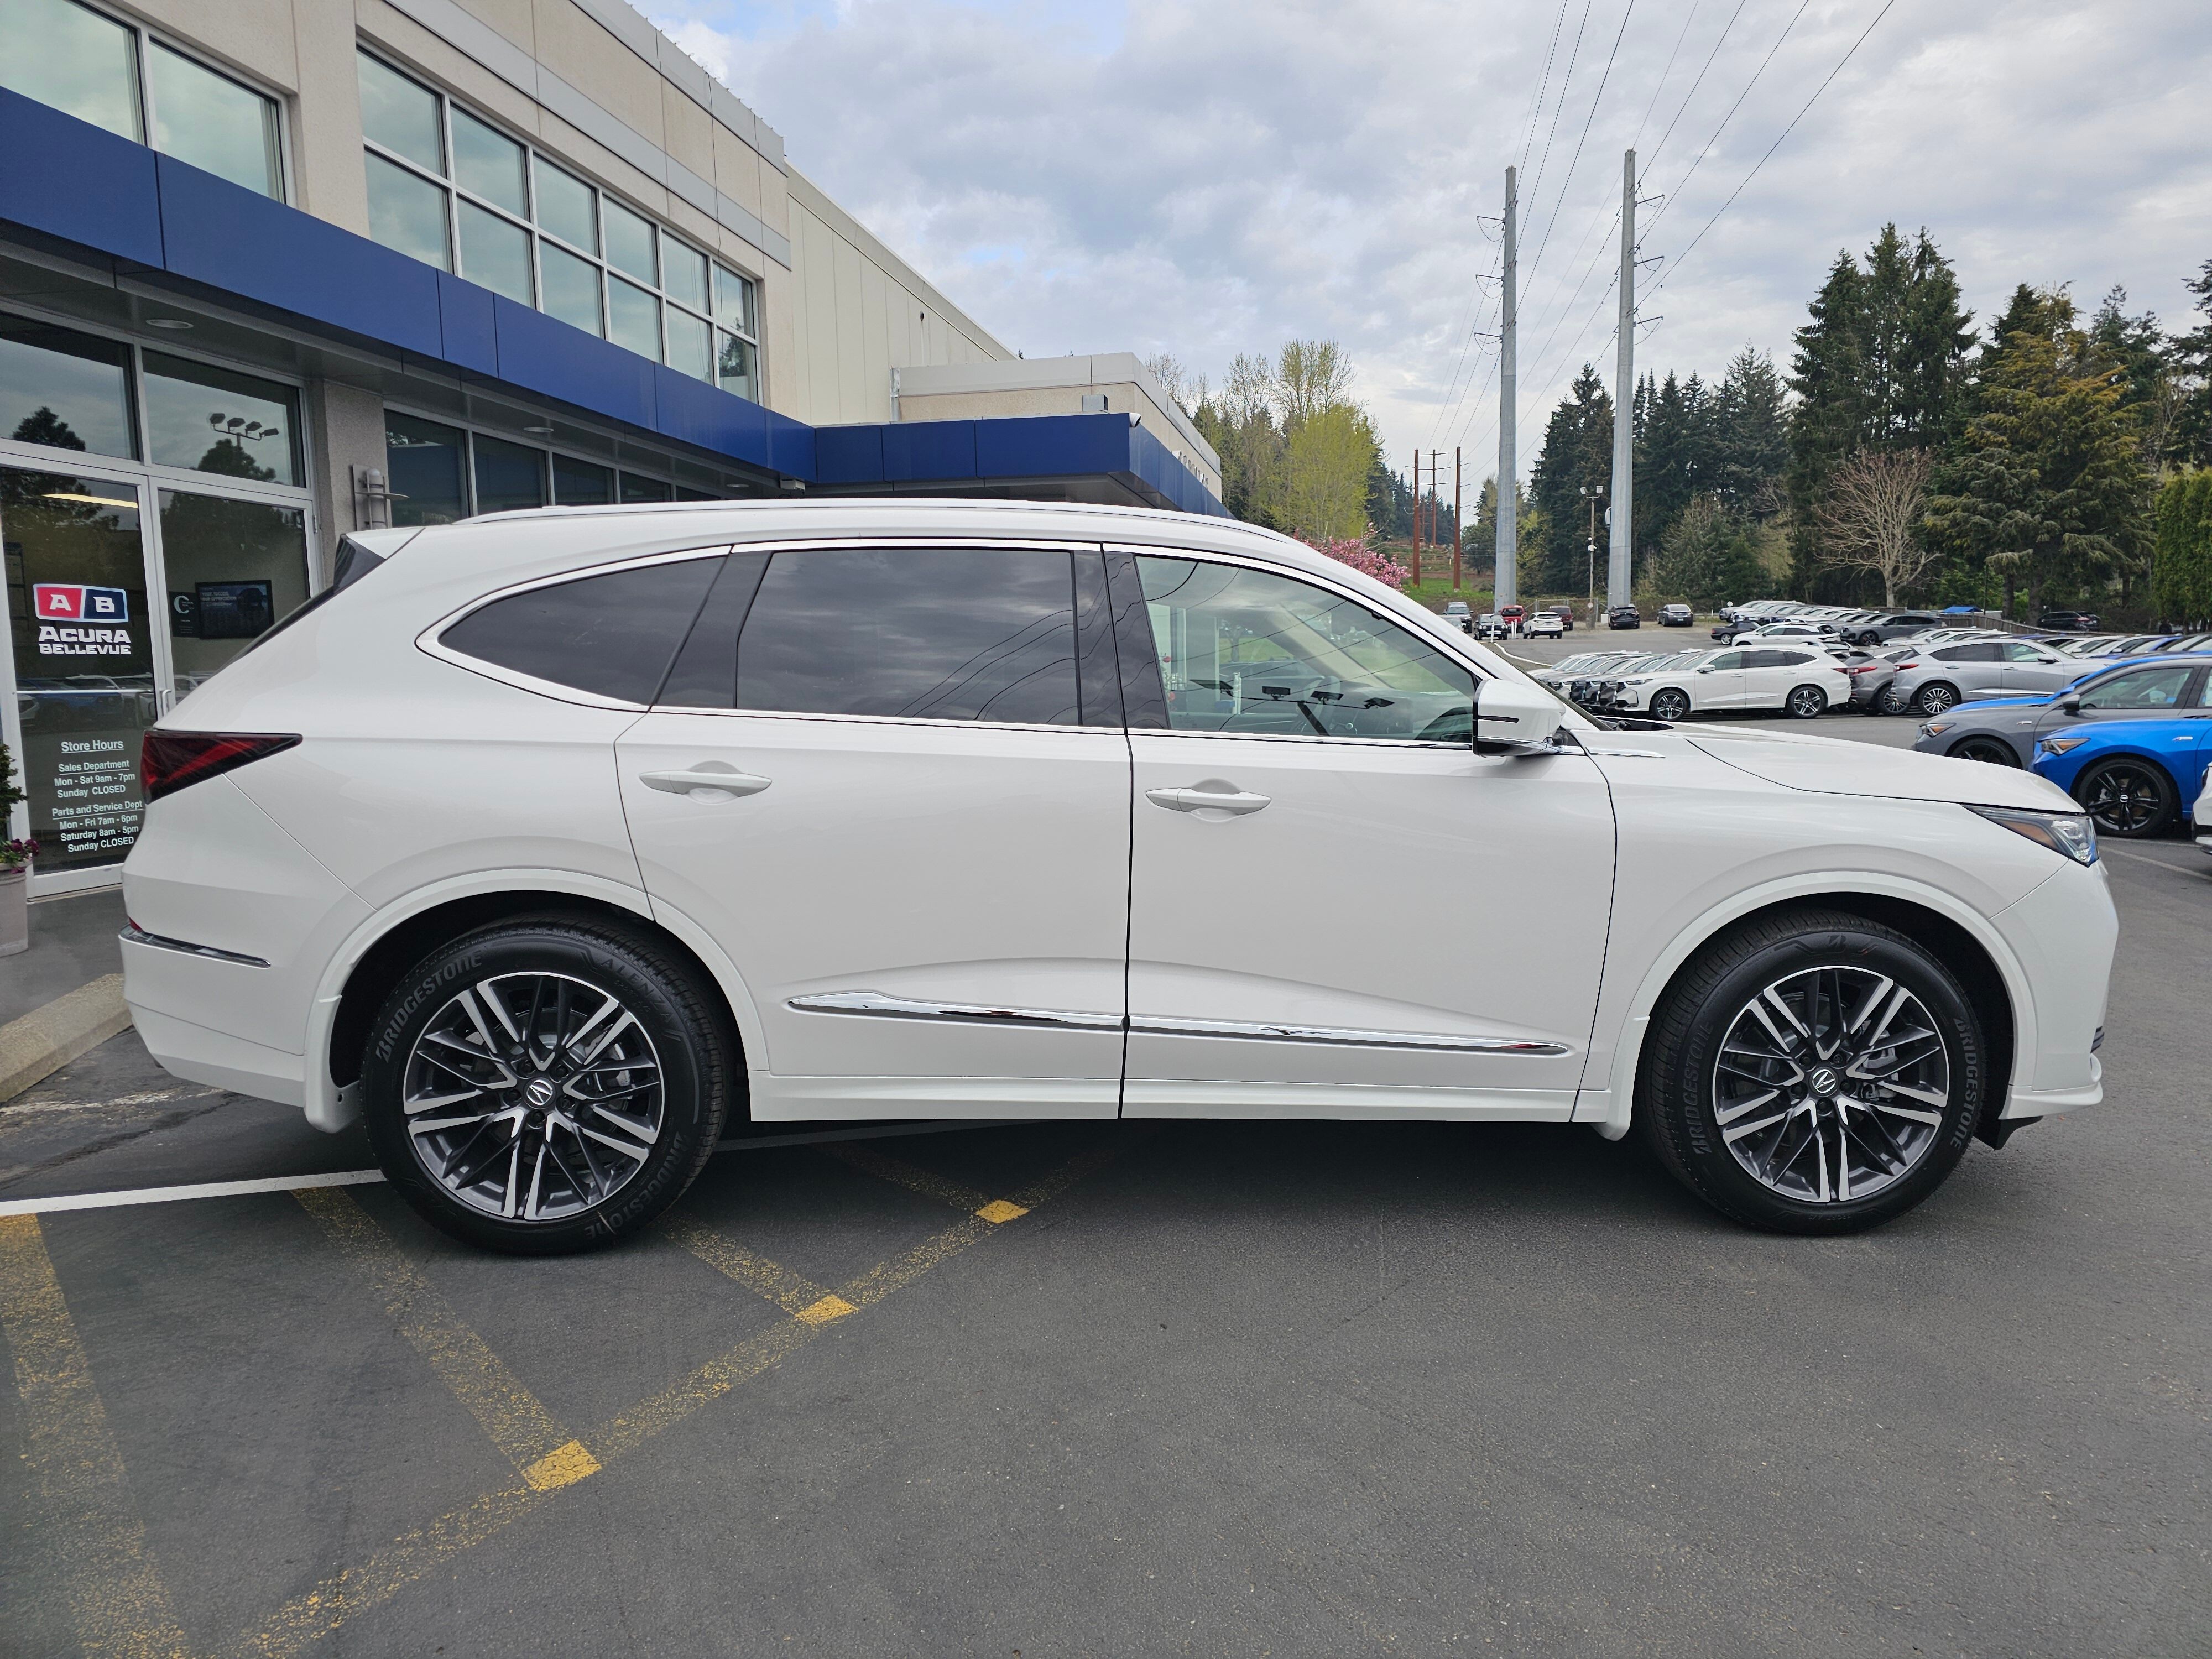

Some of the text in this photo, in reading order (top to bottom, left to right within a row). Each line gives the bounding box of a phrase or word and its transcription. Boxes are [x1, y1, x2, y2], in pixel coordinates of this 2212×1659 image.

[50, 594, 115, 613] A B
[39, 626, 131, 643] ACURA
[39, 644, 131, 654] BELLEVUE
[61, 739, 124, 752] Store Hours
[58, 759, 129, 772] Sales Department
[54, 778, 73, 786] Mon
[80, 776, 93, 784] Sat
[95, 775, 112, 783] 9am
[118, 773, 135, 782] 7pm
[57, 785, 126, 798] Sunday CLOSED
[52, 800, 143, 817] Parts and Service Dept
[59, 821, 78, 830] Mon
[85, 818, 96, 827] Fri
[121, 815, 138, 824] 6pm
[60, 831, 97, 842] Saturday
[122, 826, 139, 835] 5pm
[67, 837, 134, 853] Sunday CLOSED
[375, 950, 482, 1063] BRIDGESTONE
[1683, 1021, 1714, 1155] BRIDGESTONE
[1950, 1017, 1979, 1150] BRIDGESTONE
